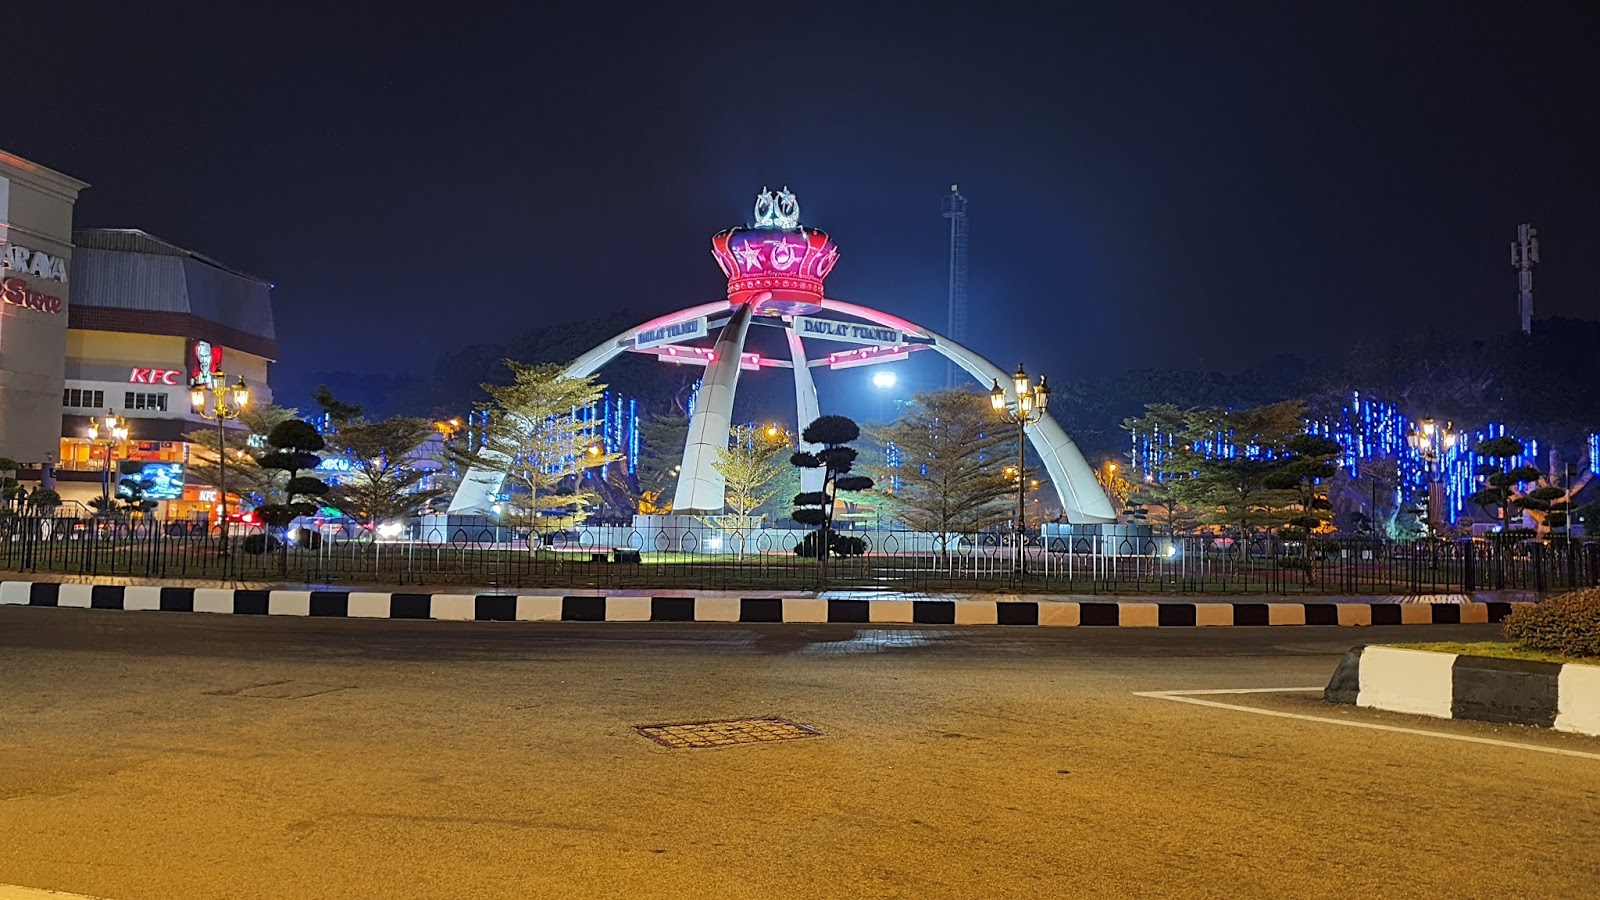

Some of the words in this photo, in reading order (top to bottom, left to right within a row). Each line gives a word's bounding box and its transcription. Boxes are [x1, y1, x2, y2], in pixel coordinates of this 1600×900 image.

[804, 319, 848, 336] DAULAT
[852, 326, 897, 342] TUANKU
[130, 367, 180, 385] KFC
[199, 490, 216, 502] KFC
